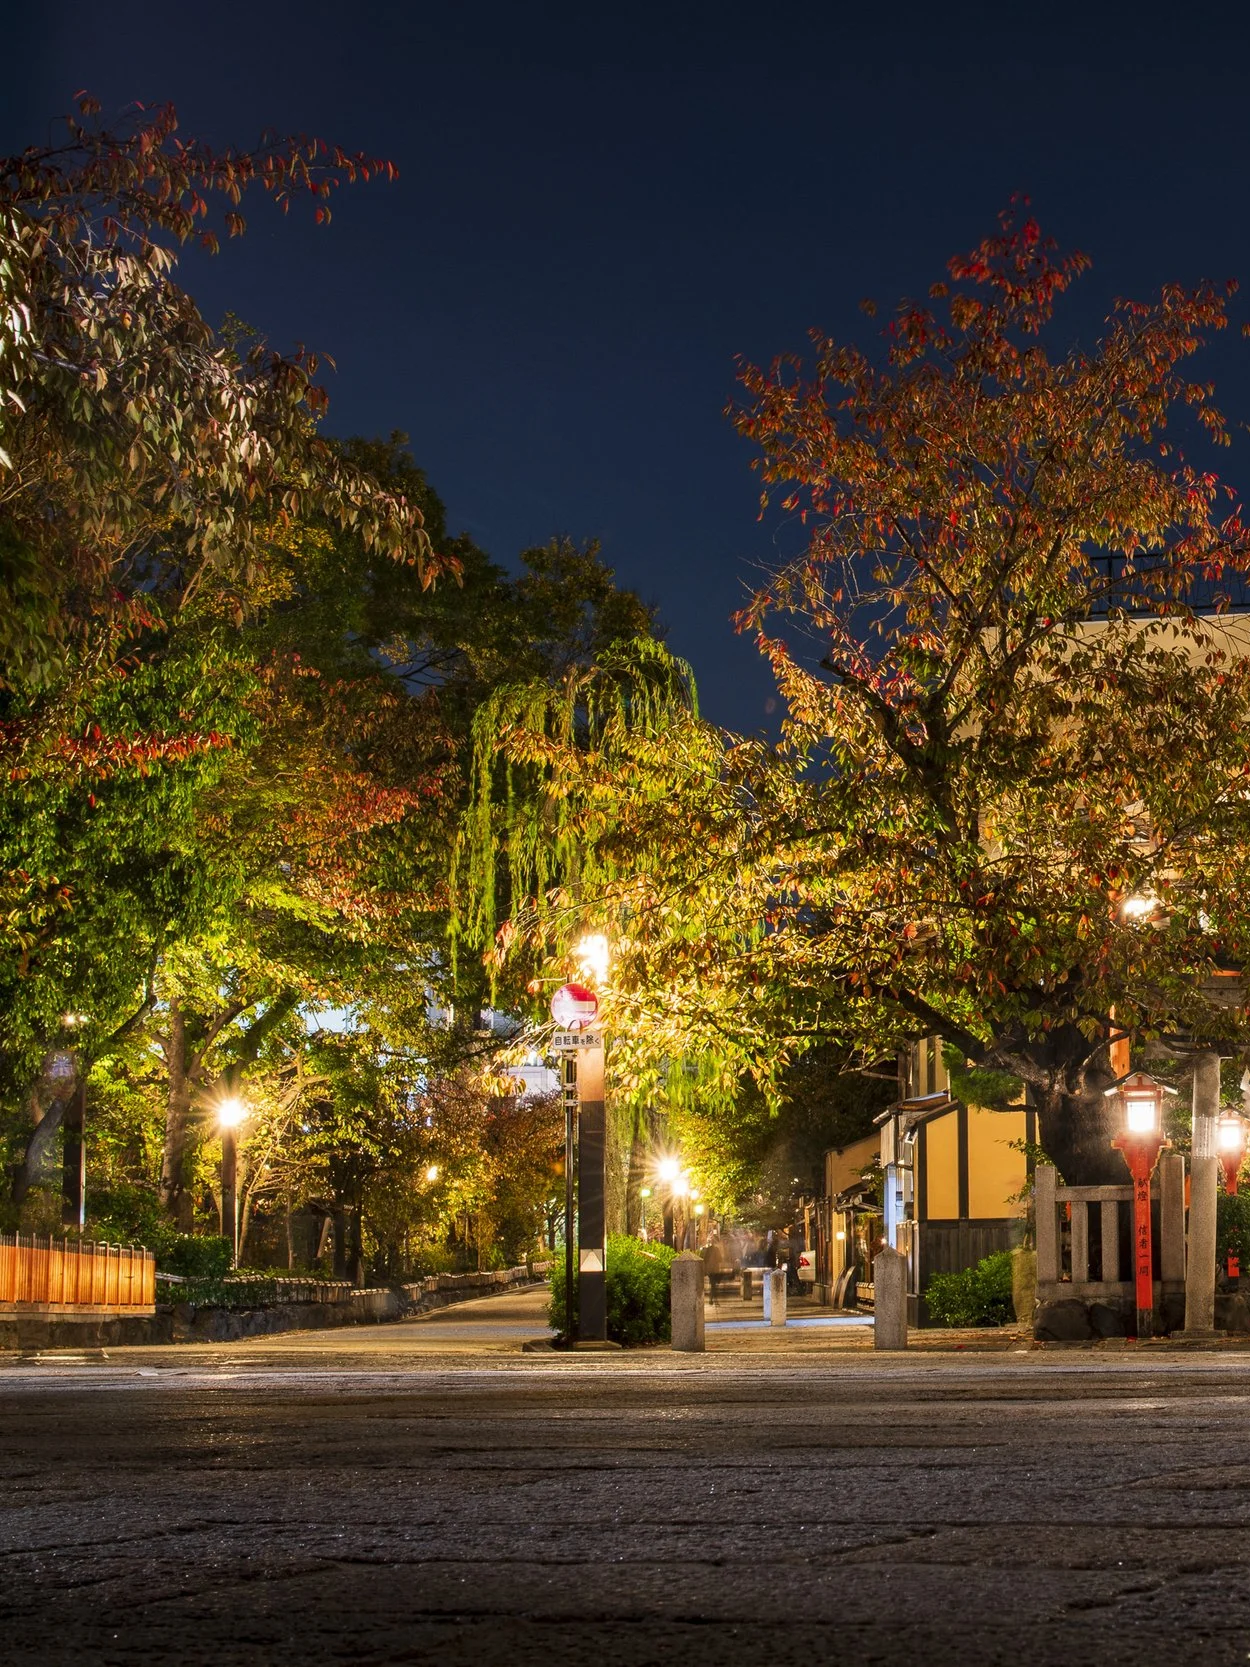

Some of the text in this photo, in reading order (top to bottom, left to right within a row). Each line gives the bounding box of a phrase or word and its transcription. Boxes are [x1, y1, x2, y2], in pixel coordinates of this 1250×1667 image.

[554, 1034, 600, 1046] 自転車を除く
